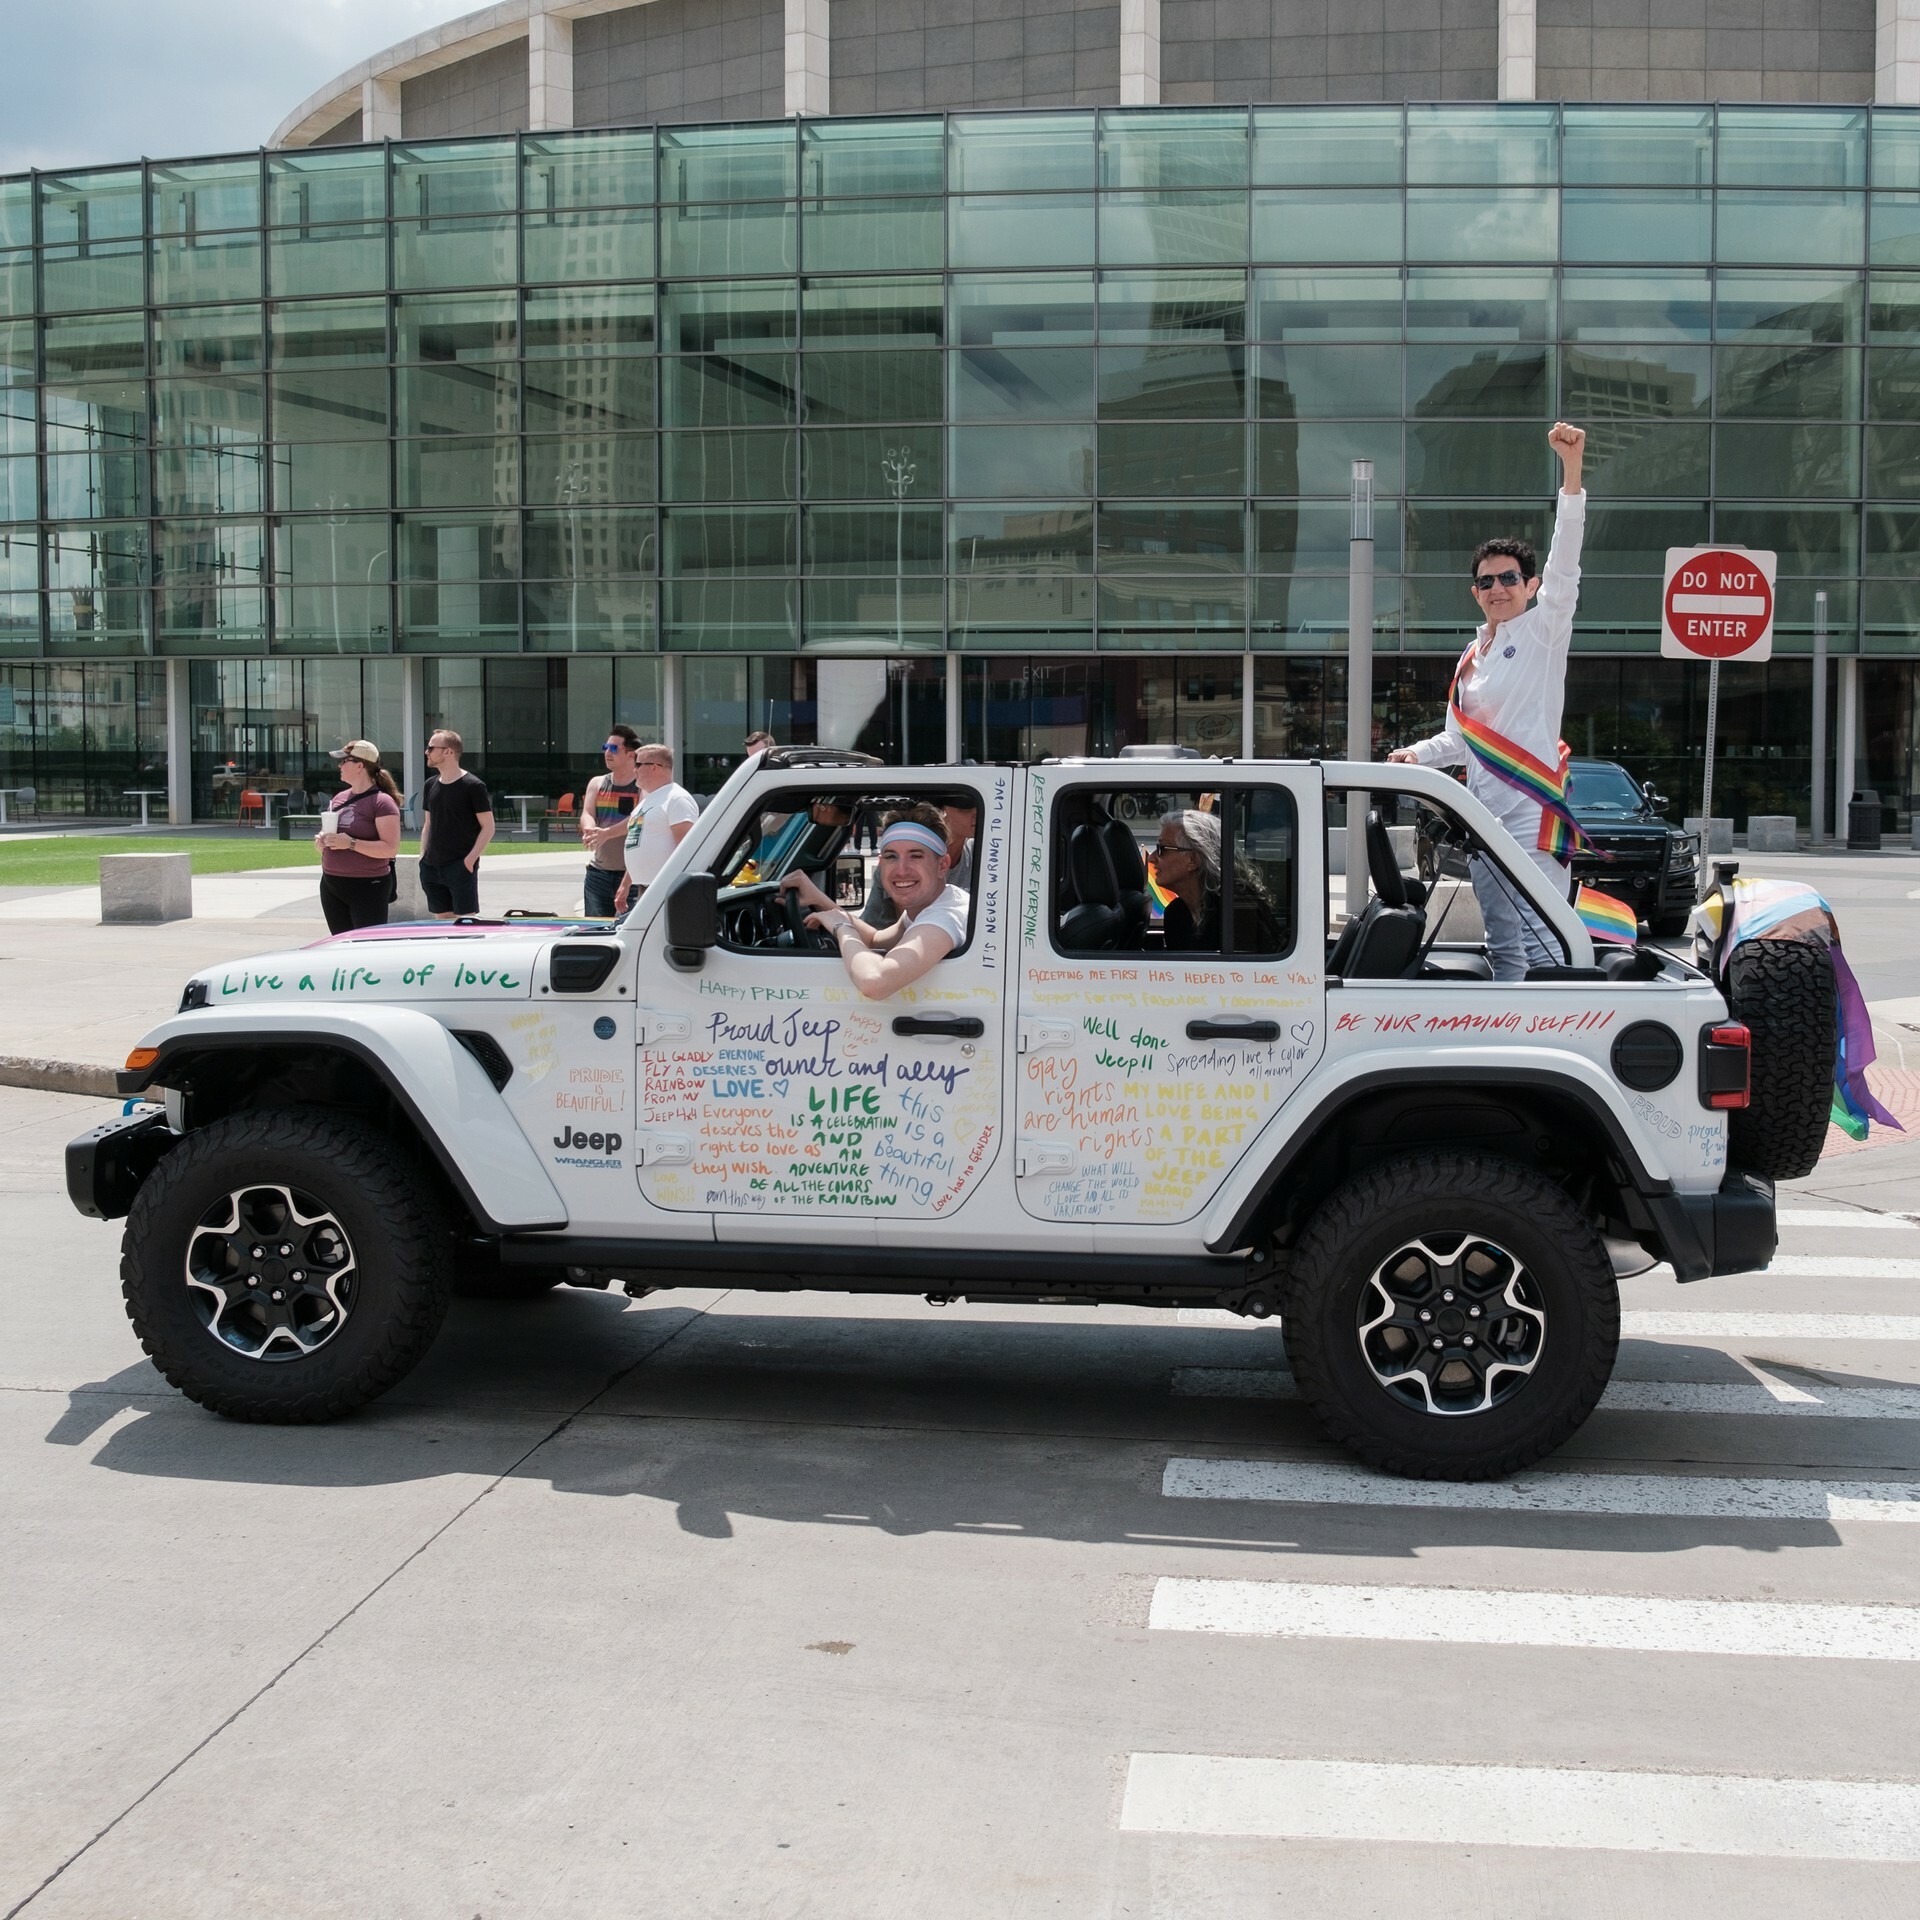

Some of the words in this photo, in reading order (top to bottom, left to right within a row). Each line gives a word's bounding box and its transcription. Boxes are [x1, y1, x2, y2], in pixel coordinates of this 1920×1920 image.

[1682, 571, 1707, 588] DO
[1720, 573, 1757, 590] NOT
[1687, 620, 1747, 637] ENTER
[877, 668, 904, 681] EIT
[1022, 665, 1052, 679] EXIT
[994, 777, 1005, 810] LOVE
[1031, 772, 1046, 843] RESPECT
[991, 818, 1002, 831] TO
[987, 837, 1002, 883] WRONG
[1030, 847, 1042, 873] FOR
[985, 889, 998, 933] NEVER
[1023, 878, 1040, 949] EVERYONE
[982, 942, 996, 968] IT'S
[299, 974, 315, 992] a
[331, 967, 381, 992] life
[402, 964, 435, 986] of
[454, 962, 520, 988] love
[1089, 970, 1107, 981] ME
[1111, 969, 1139, 980] FIRST
[1149, 969, 1175, 982] HAS
[1184, 972, 1225, 984] HELPED
[1230, 972, 1244, 983] TO
[1254, 972, 1280, 985] LOVE
[751, 986, 811, 1001] PRIDE
[1083, 1016, 1120, 1040] Well
[1335, 1013, 1367, 1031] BE
[1424, 1012, 1522, 1033] AMAZING
[705, 1012, 779, 1044] Proud
[782, 1007, 841, 1061] Jeep
[1130, 1027, 1170, 1049] done
[672, 1051, 714, 1063] GLADLY
[718, 1049, 766, 1061] EVERYONE
[1167, 1048, 1235, 1076] Spreading
[1242, 1050, 1262, 1066] love
[569, 1067, 625, 1083] PRIDE
[645, 1062, 671, 1077] FLY
[676, 1065, 685, 1076] A
[692, 1065, 757, 1077] DESERVES
[848, 1053, 889, 1087] and
[1027, 1057, 1078, 1090] Gay
[595, 1084, 604, 1095] IS
[645, 1078, 705, 1092] RAINBOW
[1123, 1083, 1149, 1099] MY
[1157, 1083, 1208, 1100] WIFE
[1214, 1084, 1256, 1100] AND
[644, 1092, 676, 1105] FROM
[682, 1092, 699, 1102] MY
[808, 1084, 880, 1115] LIFE
[899, 1086, 944, 1123] this
[1044, 1081, 1115, 1115] rights
[703, 1104, 774, 1126] Everyone
[791, 1114, 804, 1126] IS
[810, 1114, 824, 1129] A
[1023, 1111, 1062, 1131] are
[1068, 1103, 1140, 1130] human
[1145, 1104, 1191, 1121] LOVE
[1201, 1105, 1258, 1122] BEING
[1631, 1094, 1683, 1139] PROUD
[553, 1125, 622, 1155] Jeep
[700, 1123, 762, 1137] deserves
[767, 1123, 798, 1139] the
[812, 1132, 862, 1146] AND
[934, 1131, 945, 1147] a
[1160, 1125, 1172, 1141] A
[1183, 1123, 1246, 1146] PART
[1687, 1119, 1725, 1144] proud
[700, 1141, 736, 1158] right
[739, 1142, 759, 1153] to
[767, 1143, 799, 1155] love
[804, 1145, 821, 1157] as
[968, 1124, 995, 1163] GENDER
[1079, 1126, 1154, 1160] rights
[1700, 1138, 1713, 1157] of
[554, 1157, 622, 1166] WRANGLER
[839, 1148, 862, 1161] AN
[874, 1140, 955, 1176] beautiful
[1144, 1148, 1167, 1162] OF
[1178, 1148, 1225, 1169] THE
[692, 1162, 727, 1182] they
[789, 1162, 870, 1177] ADVENTURE
[963, 1164, 975, 1178] no
[1081, 1163, 1108, 1178] WHAT
[1112, 1162, 1135, 1175] WILL
[1152, 1166, 1208, 1185] JEEP
[750, 1178, 769, 1190] BE
[773, 1180, 800, 1192] ALL
[801, 1180, 825, 1192] THE
[879, 1162, 934, 1206] thing
[950, 1176, 966, 1194] has
[1049, 1178, 1086, 1193] CHANGE
[1088, 1179, 1108, 1189] THE
[1111, 1177, 1140, 1188] WORLD
[792, 1194, 814, 1205] THE
[931, 1192, 953, 1212] Love
[1043, 1194, 1051, 1206] IS
[1057, 1194, 1081, 1205] LOVE
